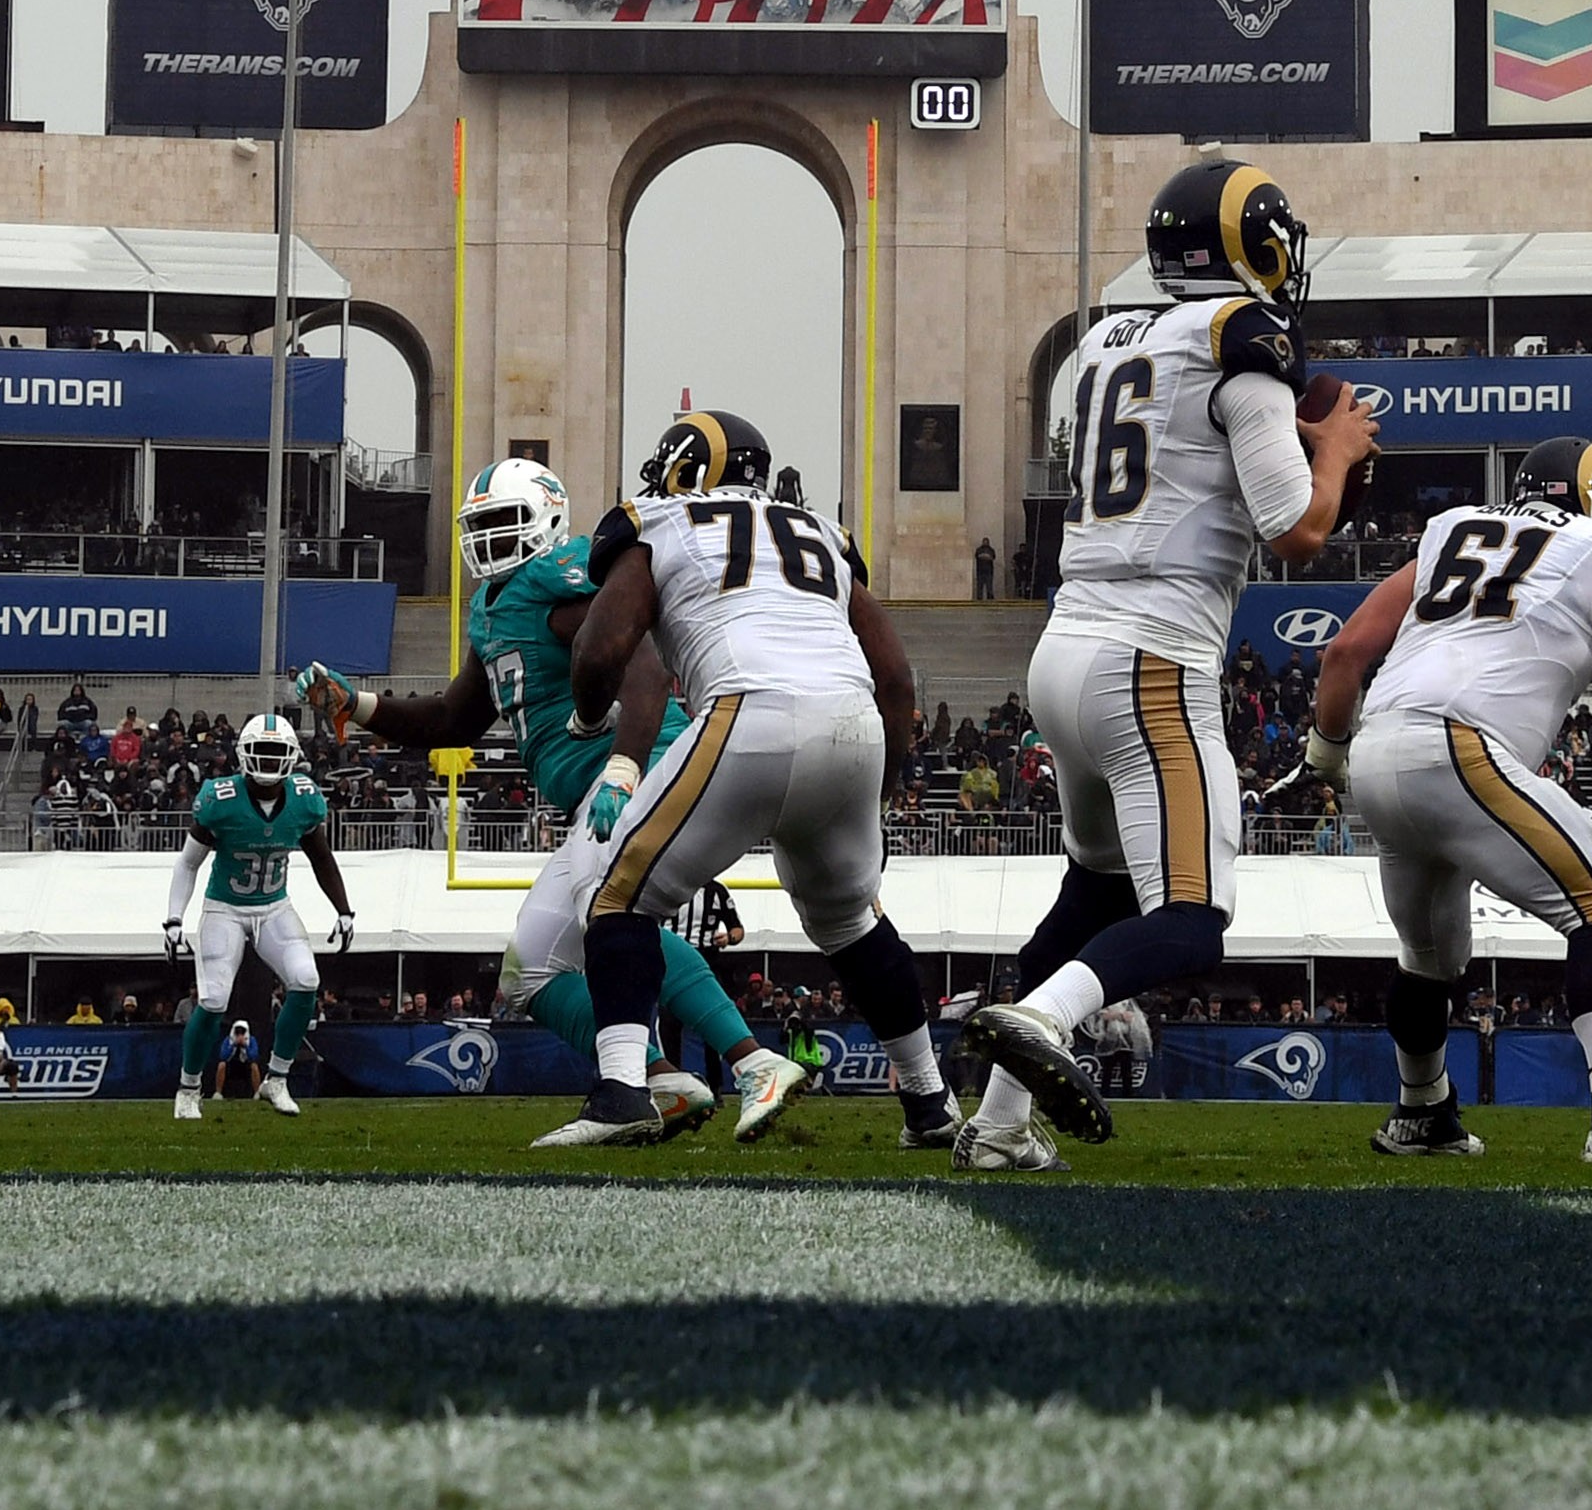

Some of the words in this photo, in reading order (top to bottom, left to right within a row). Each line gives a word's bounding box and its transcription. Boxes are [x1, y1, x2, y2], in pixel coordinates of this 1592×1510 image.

[1116, 63, 1330, 84] THERAMS.COM
[922, 86, 970, 122] 00
[1403, 385, 1572, 414] HYUNDAI
[1064, 354, 1156, 526] 16
[683, 500, 839, 601] 76
[1415, 519, 1558, 624] 61
[214, 779, 237, 800] 30
[230, 851, 289, 895] 30
[15, 1047, 41, 1055] LOS
[46, 1046, 108, 1055] ANGELES
[1388, 1116, 1435, 1141] NIKE
